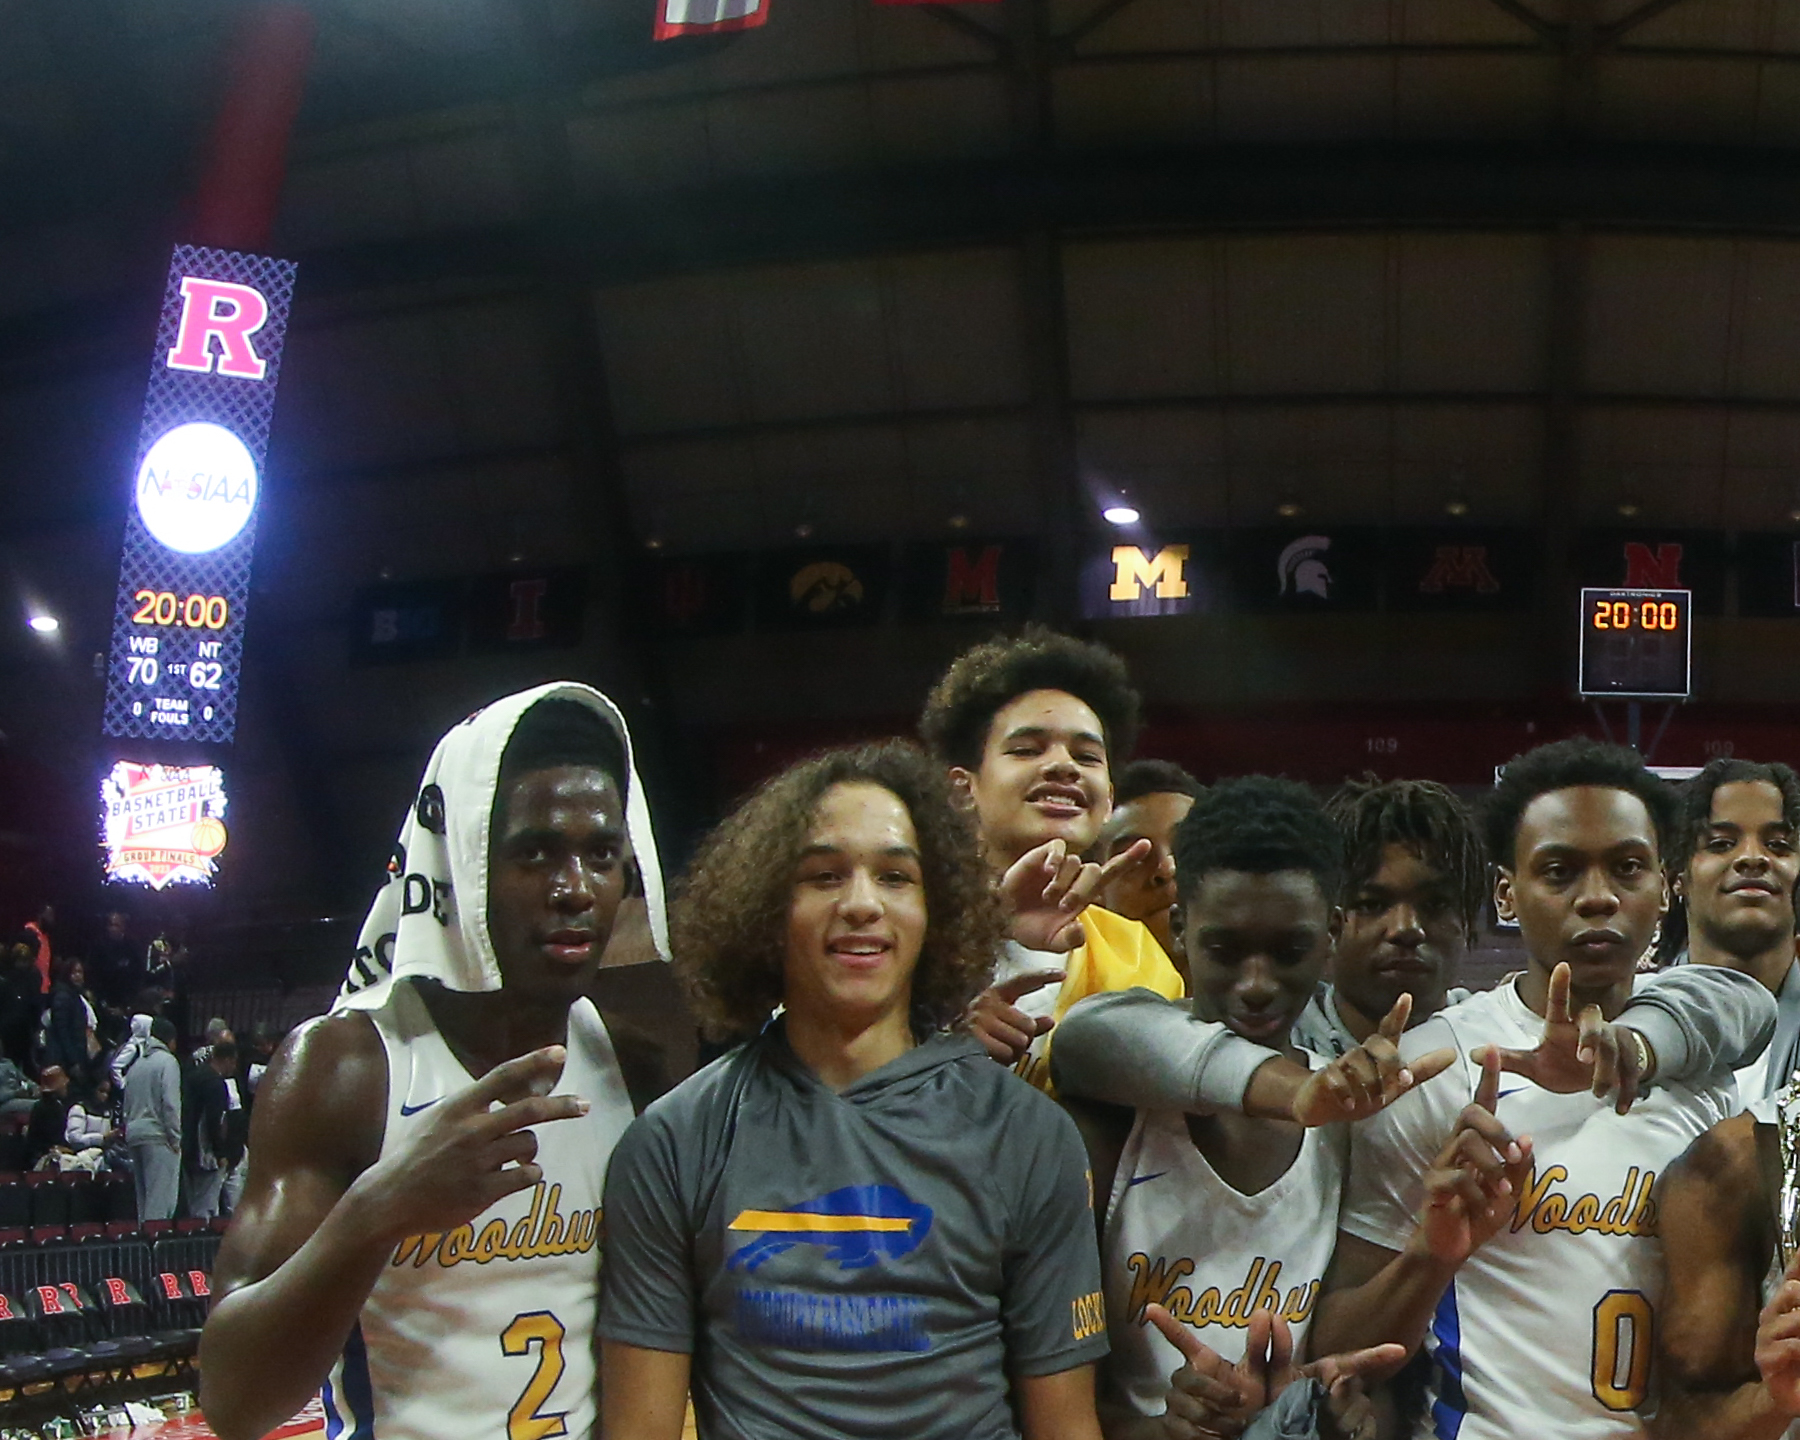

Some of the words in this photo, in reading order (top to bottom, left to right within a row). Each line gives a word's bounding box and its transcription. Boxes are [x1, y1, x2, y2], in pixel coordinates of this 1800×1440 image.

[167, 276, 268, 380] R
[142, 467, 250, 505] NSIAA
[943, 546, 1000, 612] M
[1110, 544, 1190, 600] M
[132, 589, 229, 630] 20:00
[1593, 600, 1679, 631] 20:00
[130, 636, 159, 655] WB
[198, 641, 222, 659] NT
[126, 656, 158, 685] 70
[167, 663, 187, 676] 1ST
[189, 661, 222, 690] 62
[150, 711, 189, 726] FOULS
[154, 698, 189, 712] TEAM
[112, 782, 219, 817] BASKETBALL
[134, 805, 188, 830] STATE
[123, 850, 156, 863] GROUP
[159, 849, 195, 864] FINALS
[106, 1277, 132, 1305] R
[160, 1272, 183, 1299] R
[187, 1270, 211, 1297] R
[36, 1285, 65, 1315] R
[1591, 1289, 1654, 1412] 0
